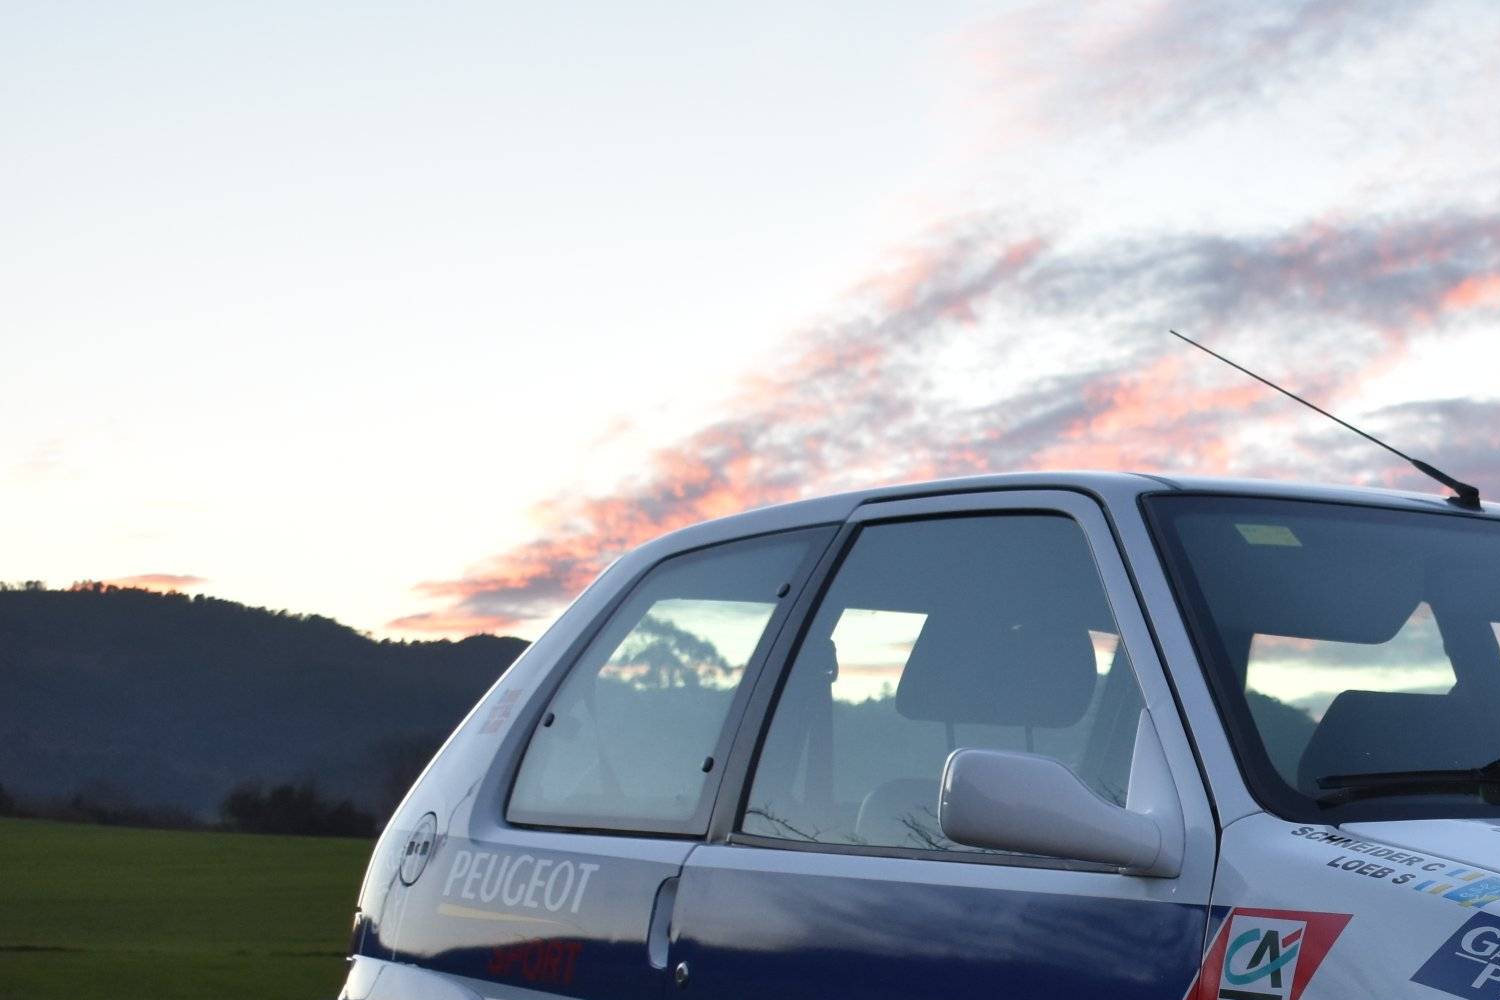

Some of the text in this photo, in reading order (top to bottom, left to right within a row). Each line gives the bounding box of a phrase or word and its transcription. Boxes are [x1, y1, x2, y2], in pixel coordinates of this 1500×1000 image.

[1290, 825, 1425, 867] SCHNEIDER
[442, 849, 601, 914] PEUGEOT
[1326, 855, 1417, 885] LOEB S
